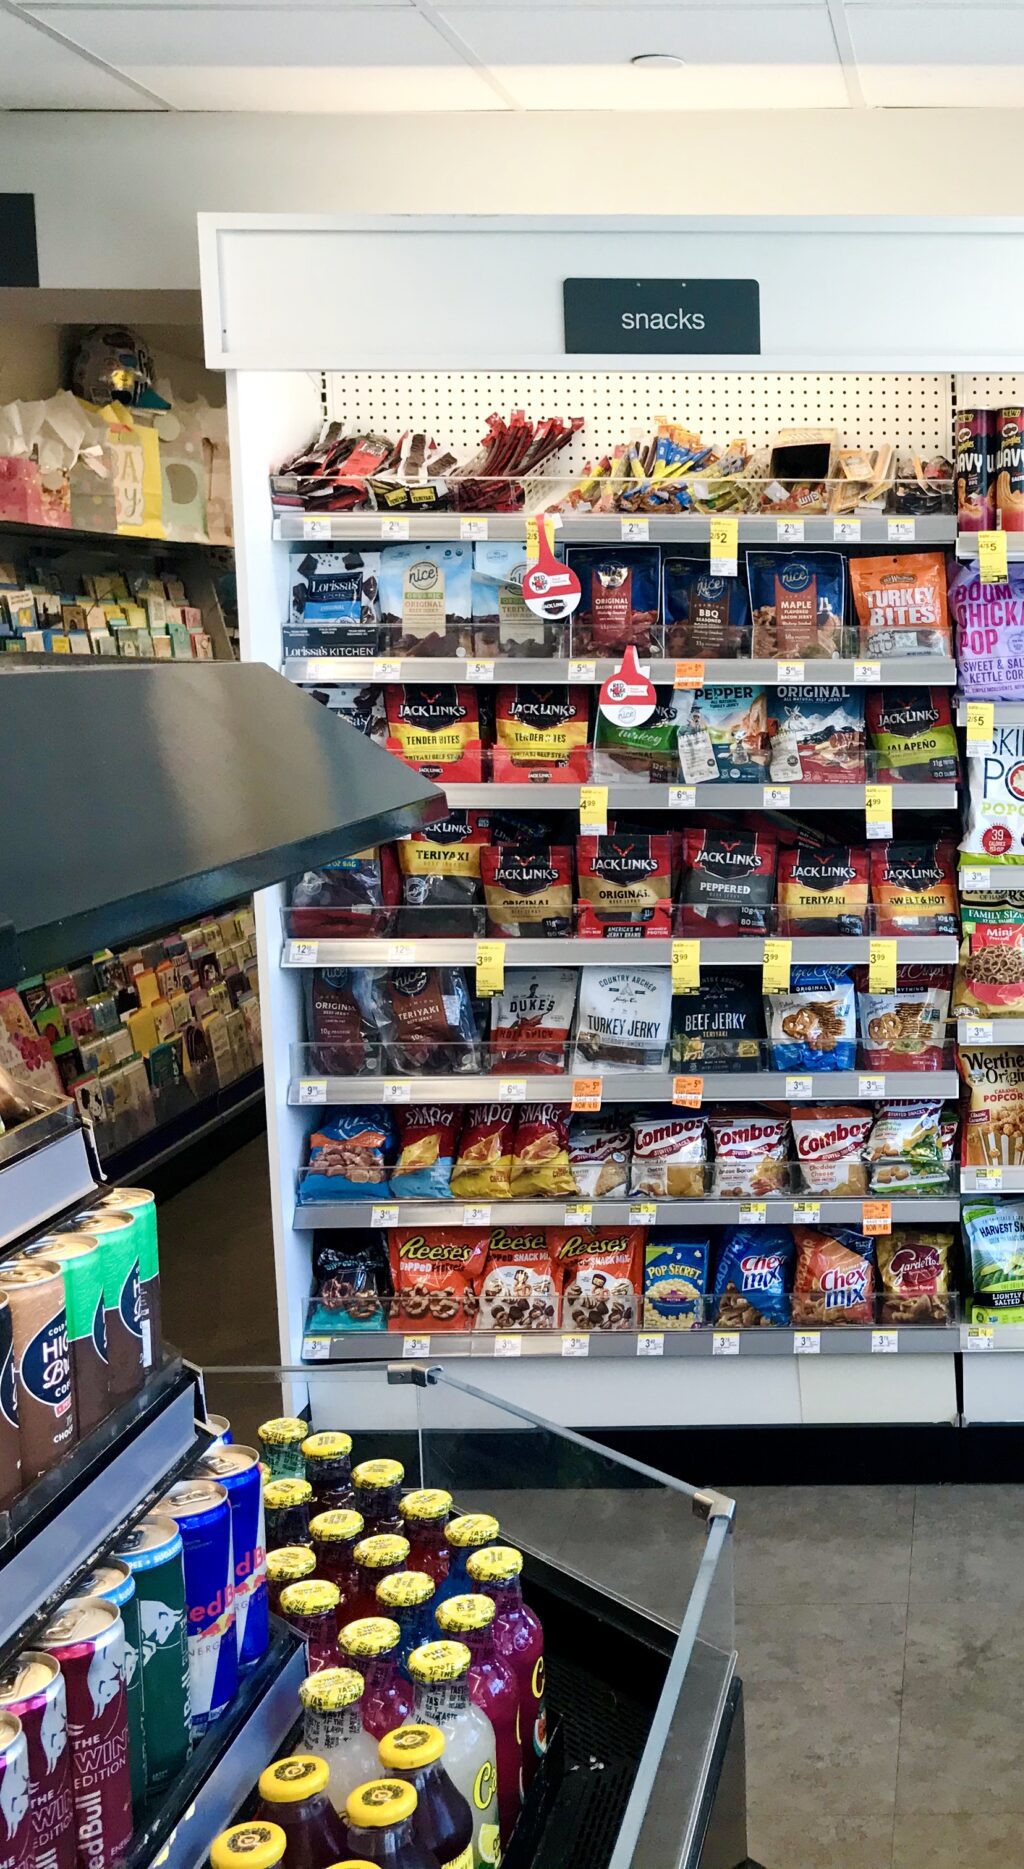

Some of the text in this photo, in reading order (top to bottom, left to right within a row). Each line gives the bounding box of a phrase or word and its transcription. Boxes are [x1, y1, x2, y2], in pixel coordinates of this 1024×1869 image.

[620, 308, 706, 330] snacks
[864, 586, 934, 608] TURKEY
[954, 582, 1012, 604] BOOM
[780, 601, 812, 609] MAPLE
[699, 609, 720, 618] BBQ
[870, 606, 936, 626] BITES
[960, 629, 998, 657] POP
[964, 660, 994, 672] SWEET
[997, 660, 1004, 670] &
[969, 672, 1004, 684] KETTLE
[694, 687, 754, 700] PEPPER
[776, 686, 850, 698] ORIGINAL
[398, 704, 427, 717] JACK
[508, 702, 536, 716] JACK
[878, 712, 904, 727] JACK
[406, 735, 460, 746] TENDER BITES
[618, 727, 662, 746] Turkey
[991, 829, 1004, 840] 39
[415, 850, 470, 861] TERIYAKI
[694, 851, 728, 865] JACK
[590, 858, 620, 870] JACK
[790, 865, 818, 878] JACK
[494, 868, 520, 881] JACK
[882, 869, 910, 880] JACK
[699, 882, 751, 895] PEPPERED
[799, 896, 846, 905] TERIYAKI
[986, 927, 1013, 938] Mini
[398, 1005, 440, 1022] TERIYAKI
[588, 1014, 661, 1039] TURKEY JERKY
[685, 1012, 747, 1032] BEEF JERKY
[634, 1118, 703, 1150] Combos
[714, 1122, 785, 1148] Combos
[798, 1121, 870, 1156] Combos
[979, 1223, 1012, 1238] HARVEST
[400, 1236, 472, 1261] Reese's
[558, 1234, 630, 1260] Reese's
[740, 1254, 785, 1272] Chex
[646, 1263, 702, 1280] POP SECRET
[820, 1263, 867, 1290] Chex
[992, 1292, 1022, 1301] LIGHTLY
[994, 1298, 1021, 1307] SALTED
[74, 1733, 100, 1751] THE
[74, 1758, 127, 1790] EDITION
[30, 1791, 55, 1809] THE
